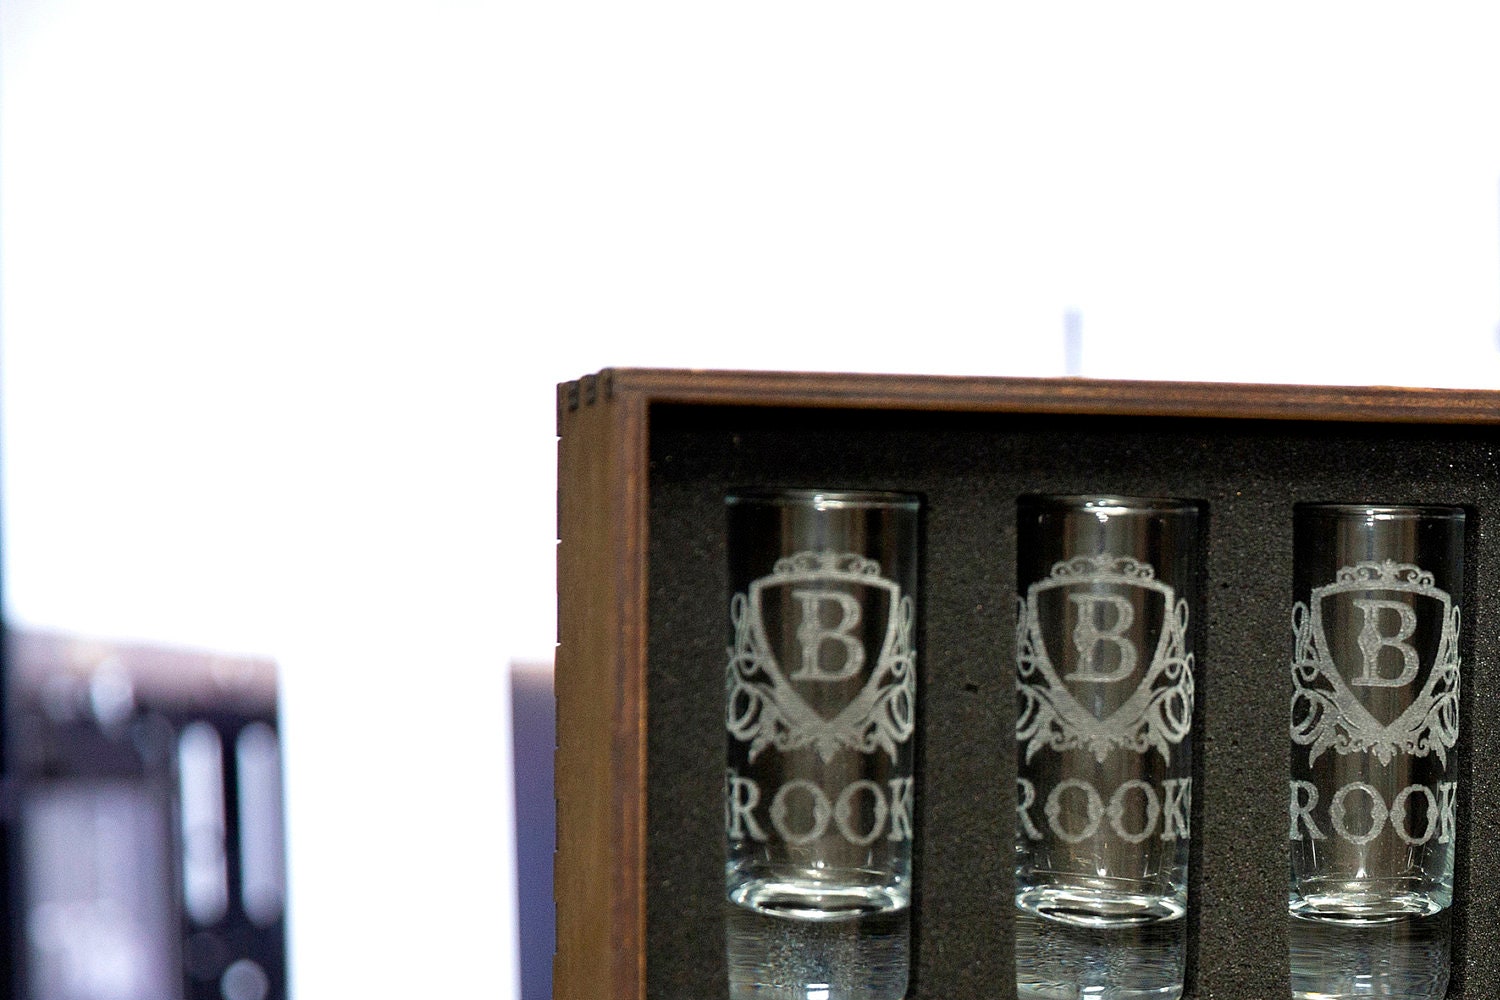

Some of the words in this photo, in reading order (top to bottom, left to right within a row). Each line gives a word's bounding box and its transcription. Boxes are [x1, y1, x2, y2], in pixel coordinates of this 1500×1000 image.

[791, 590, 867, 681] B
[1064, 593, 1138, 683] B
[1352, 600, 1420, 687] B
[726, 768, 914, 845] ROOK
